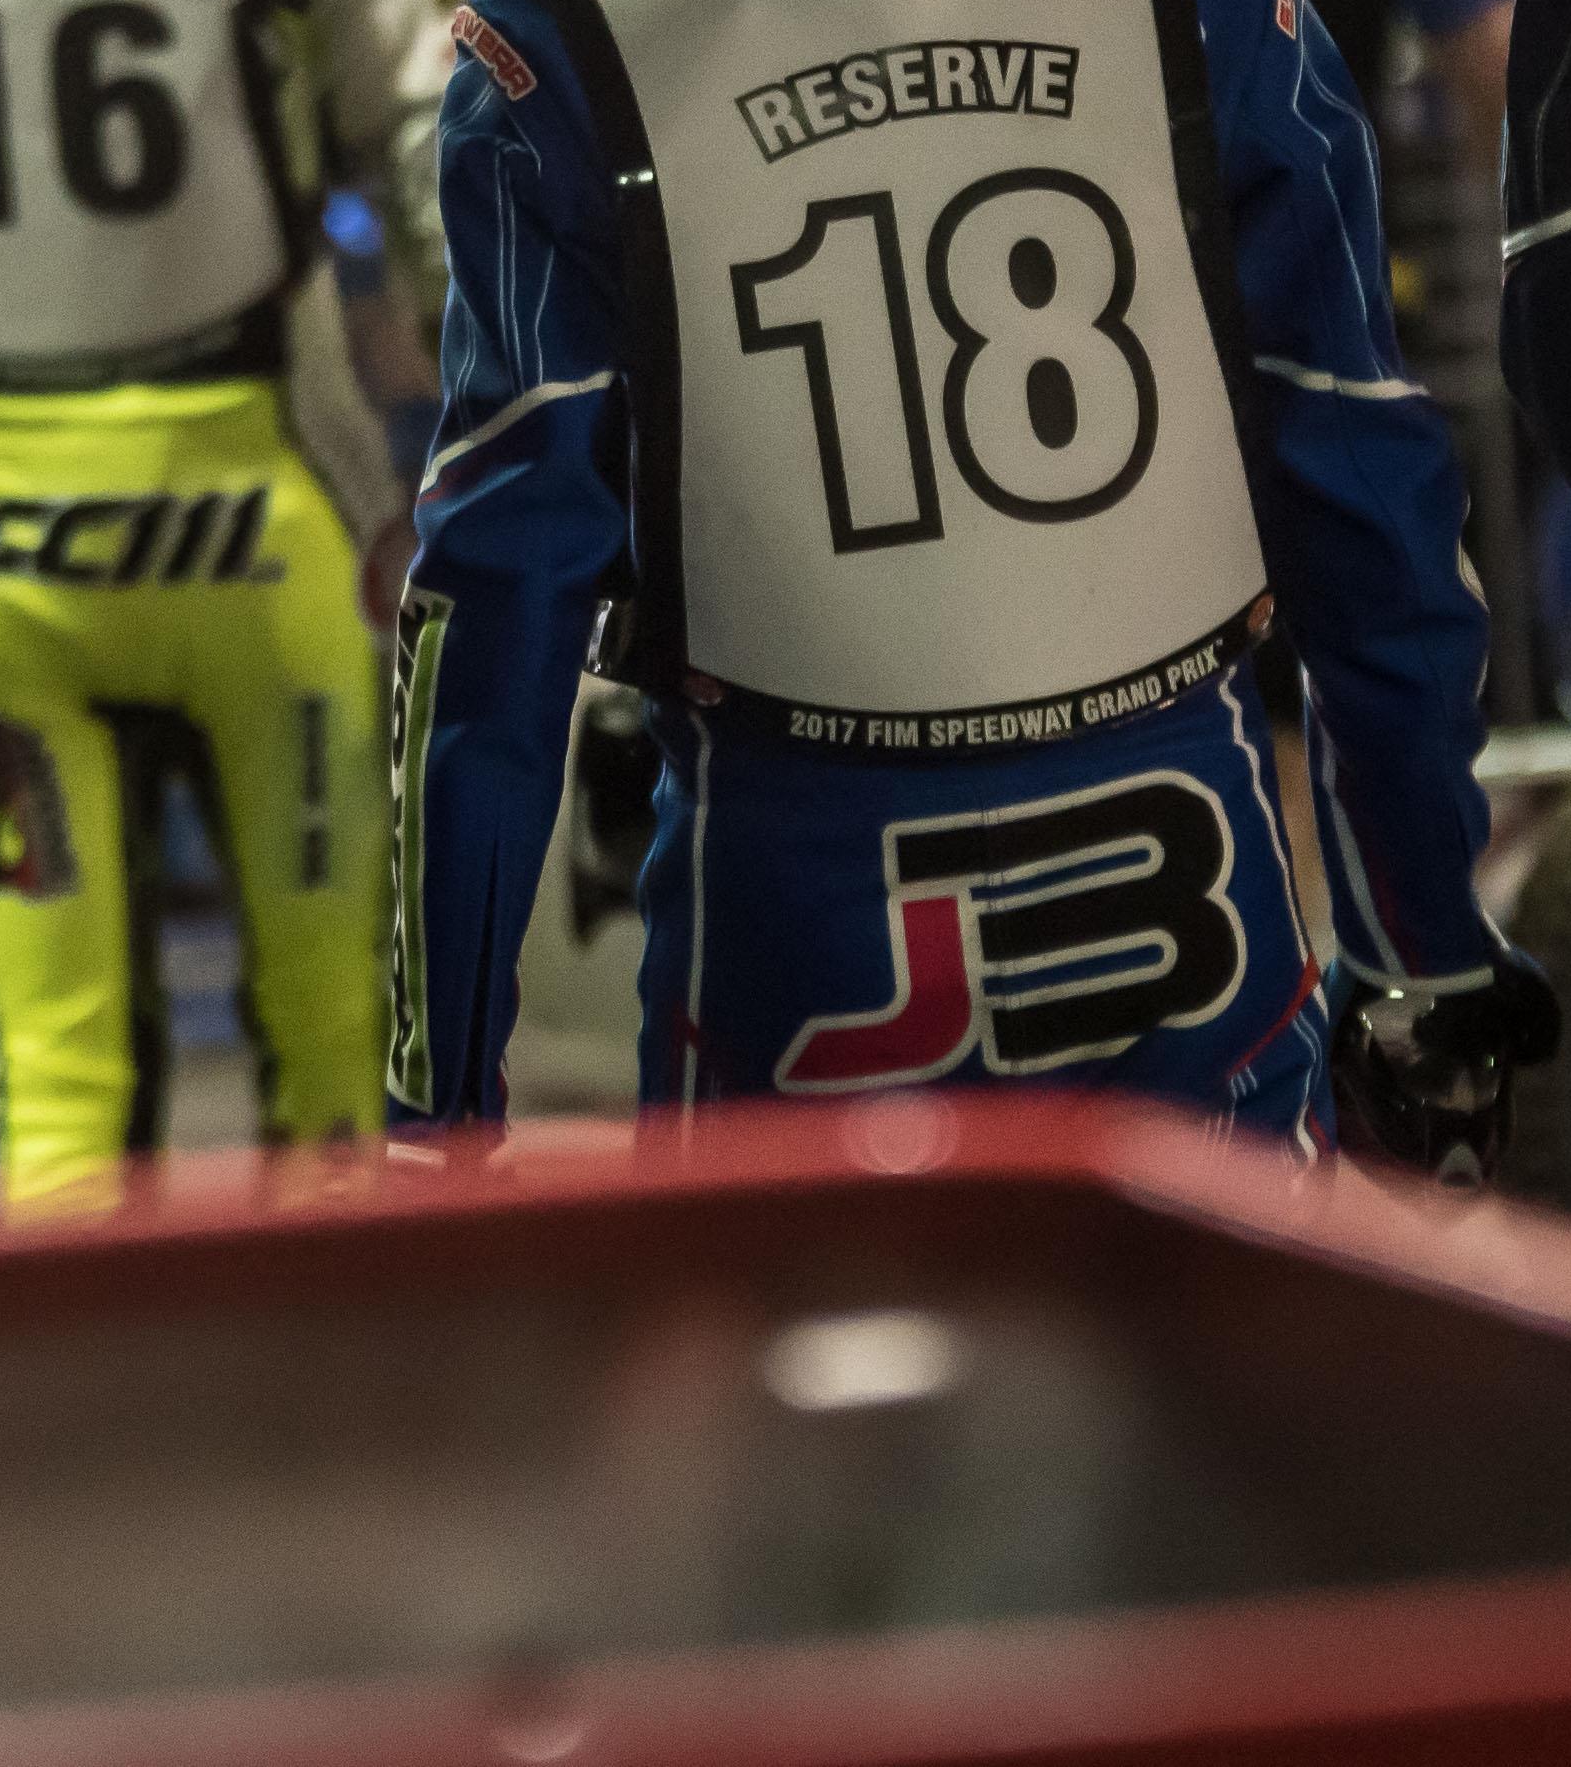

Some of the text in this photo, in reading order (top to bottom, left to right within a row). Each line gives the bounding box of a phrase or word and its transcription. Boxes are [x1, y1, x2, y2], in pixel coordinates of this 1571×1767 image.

[734, 40, 1080, 163] RESERVE
[728, 166, 1160, 555] 18
[789, 709, 857, 745] 2017
[865, 719, 920, 748] FIM
[929, 699, 1074, 748] SPEEDWAY
[1080, 676, 1162, 725] GRAND
[773, 768, 1247, 1095] JB
